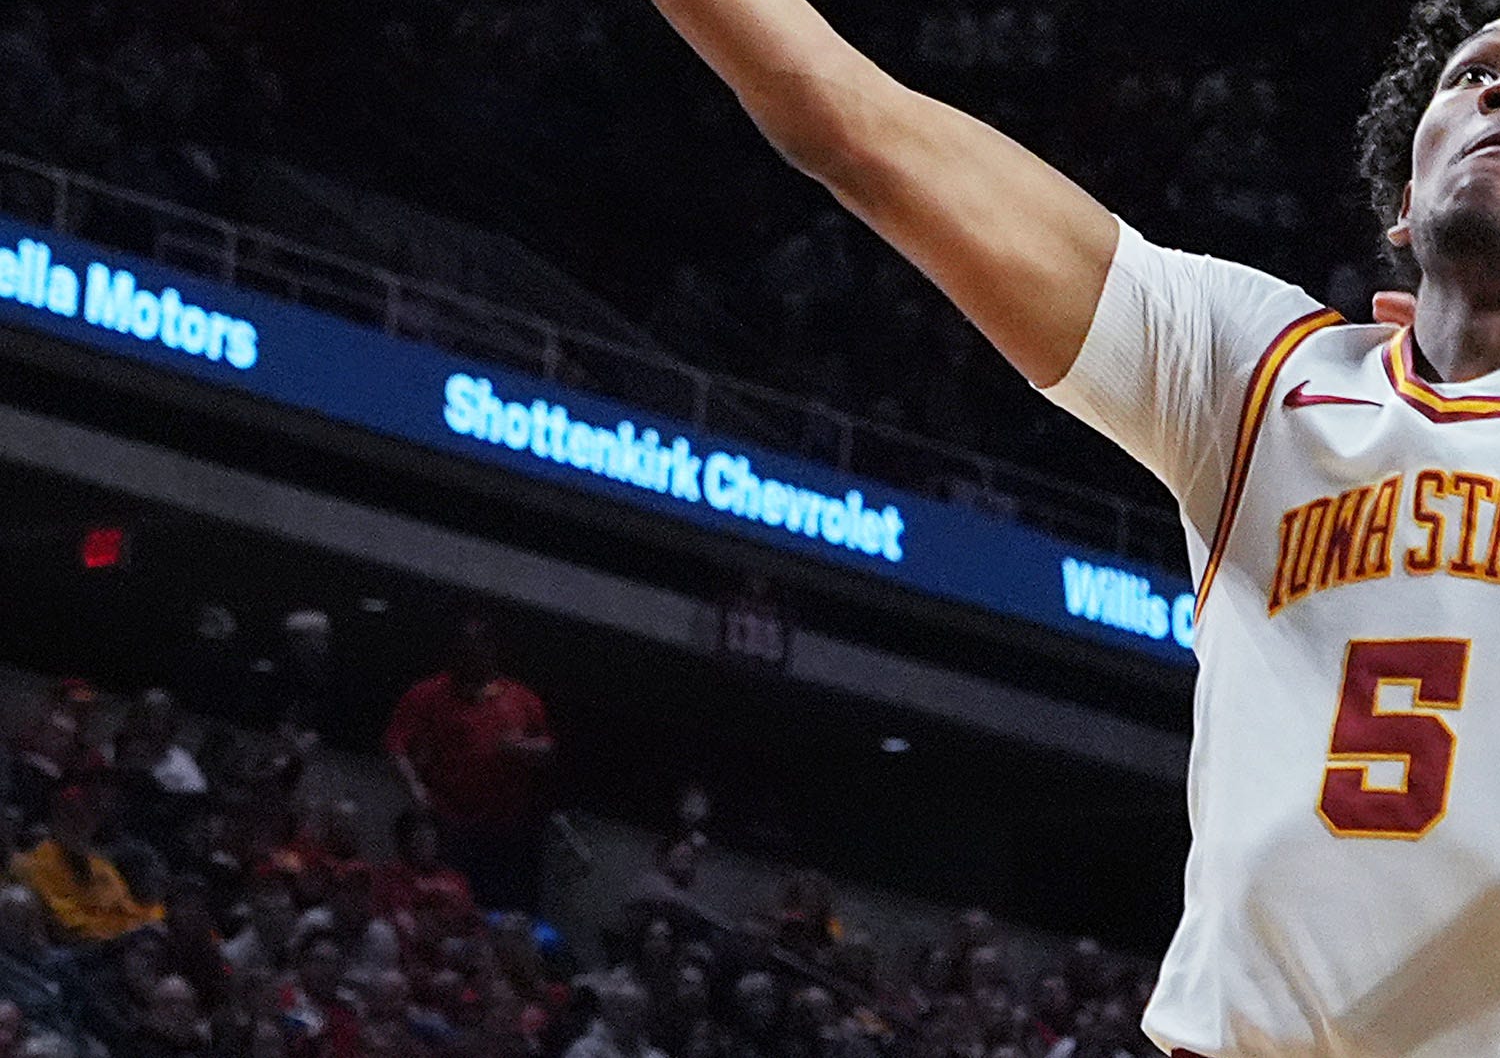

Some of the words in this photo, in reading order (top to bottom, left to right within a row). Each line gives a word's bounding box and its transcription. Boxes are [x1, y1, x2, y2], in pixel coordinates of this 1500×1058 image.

[83, 262, 258, 369] Motors
[444, 373, 701, 502] Shottenkirk
[703, 452, 904, 562] Chevrolet
[1061, 557, 1170, 640] Willis
[1267, 473, 1404, 619] IOWA
[1316, 639, 1472, 839] 5
